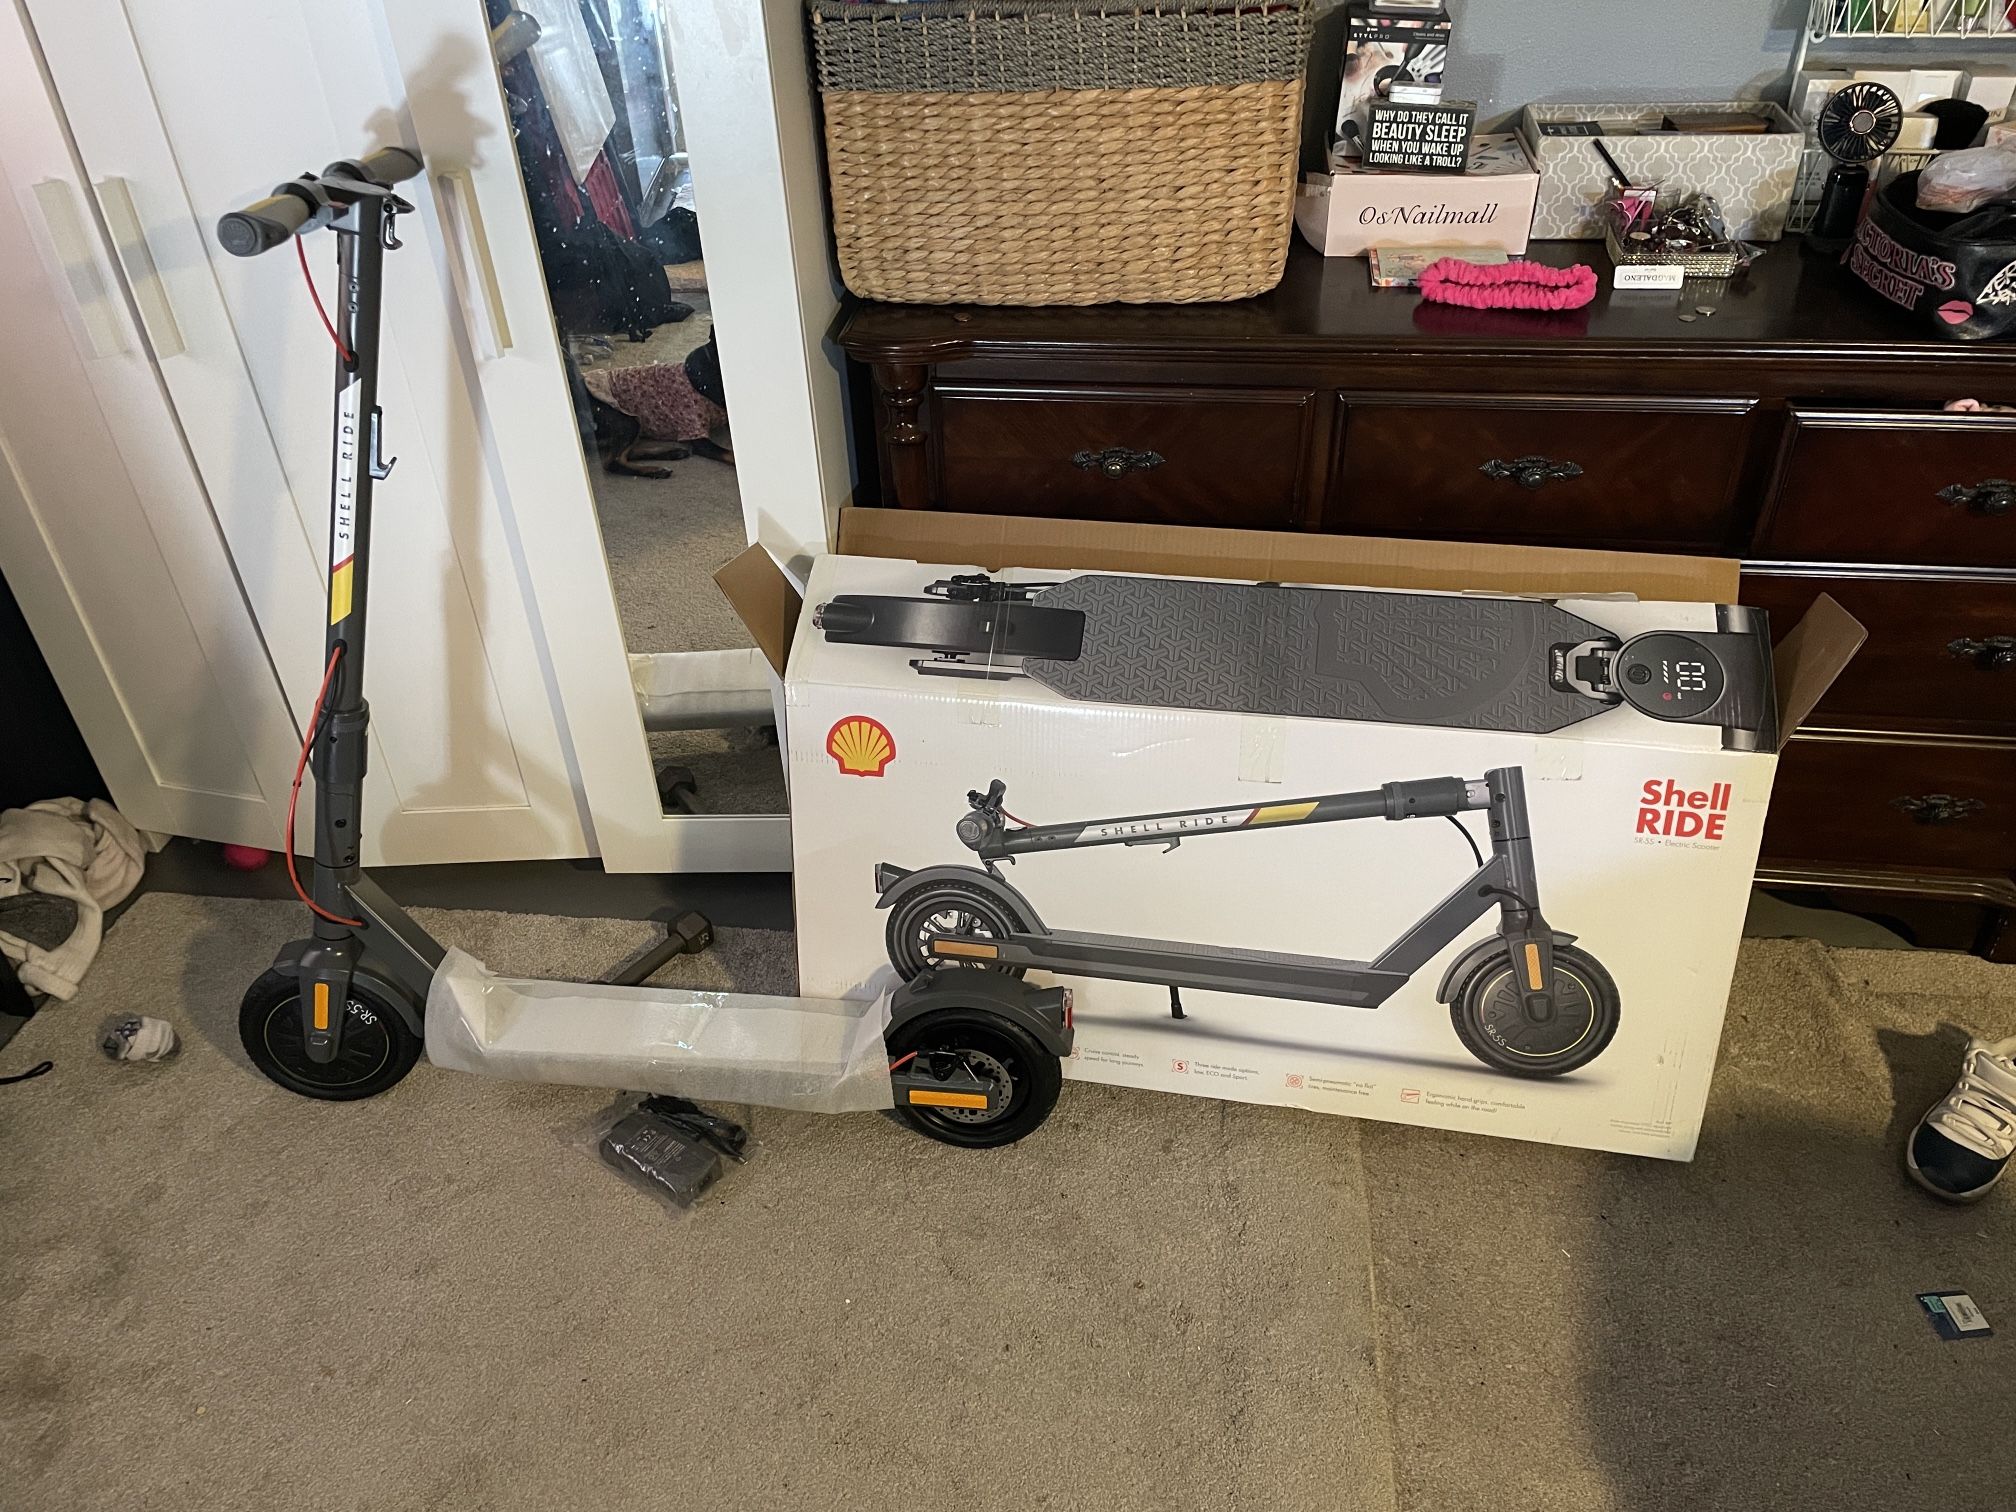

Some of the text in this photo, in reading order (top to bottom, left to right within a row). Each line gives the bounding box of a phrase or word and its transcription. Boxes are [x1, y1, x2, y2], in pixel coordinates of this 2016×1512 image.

[1375, 109, 1468, 125] WHY DO THEY CALL IT
[1372, 122, 1467, 142] BEAUTY SLEEP
[1371, 139, 1464, 156] WHEN YOU WAKE UP
[1369, 152, 1462, 168] LOOKING LIKE A TROLL?
[1851, 243, 1925, 311] SECRET
[339, 410, 355, 540] SHELL RIDE
[1640, 779, 1732, 811] Shell
[1100, 815, 1228, 837] SHELL RIDE
[1636, 808, 1727, 840] RIDE
[1665, 839, 1690, 849] Electric
[1692, 842, 1720, 851] Scooter
